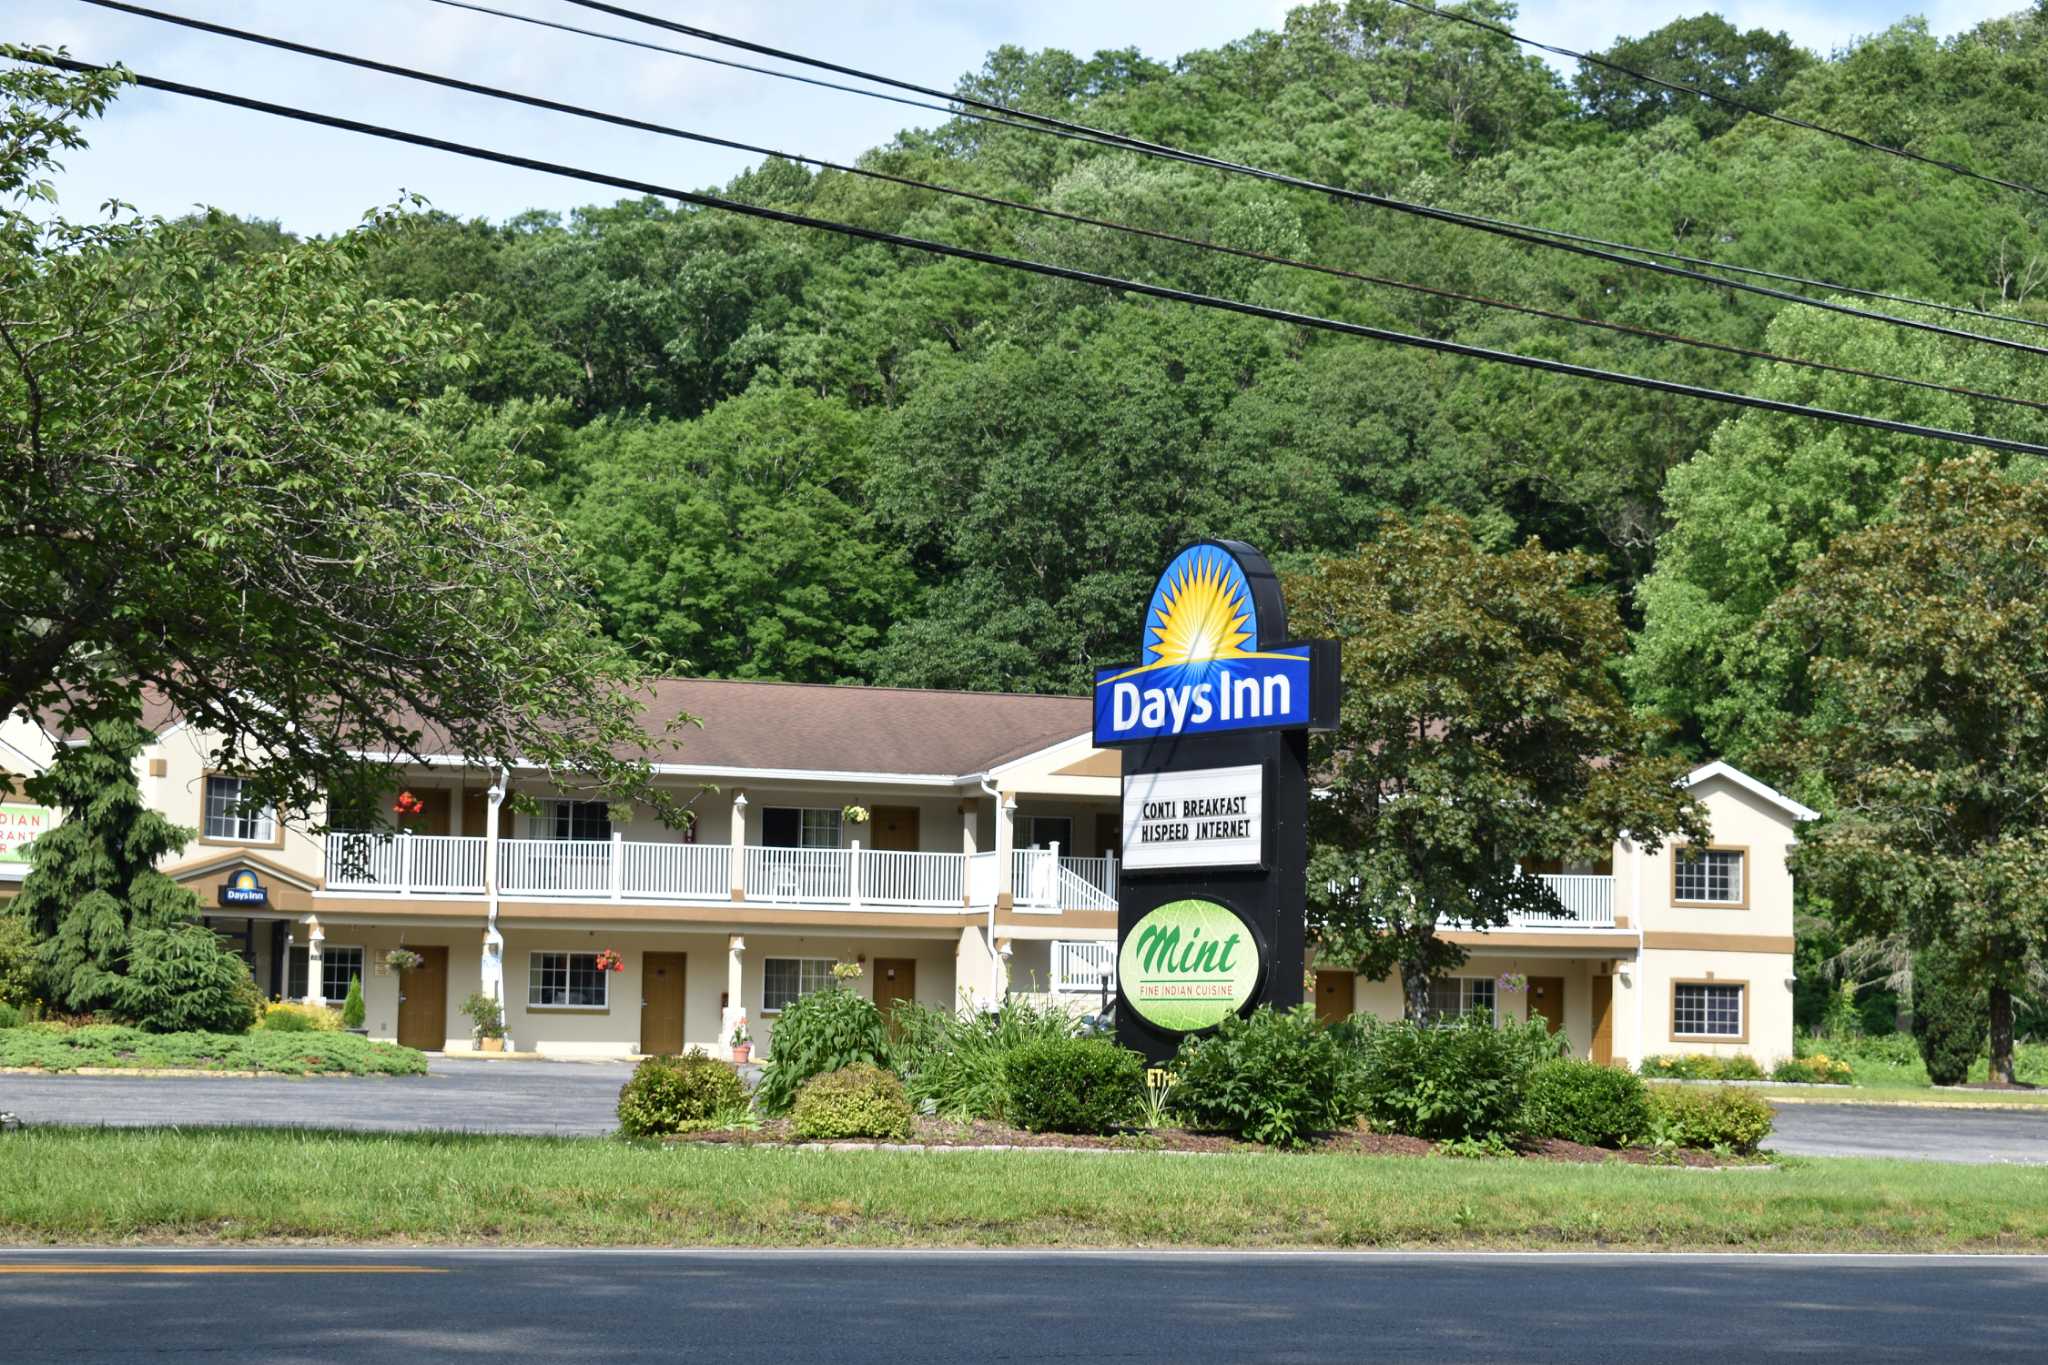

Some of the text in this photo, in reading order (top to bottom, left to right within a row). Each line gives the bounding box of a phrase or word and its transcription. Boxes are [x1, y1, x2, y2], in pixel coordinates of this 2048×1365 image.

[1113, 670, 1291, 734] Days Inn
[1143, 796, 1247, 819] CONTI BREAKFAST
[1141, 819, 1251, 843] HISPEED INTERNET
[227, 890, 264, 900] Days Inn
[1136, 924, 1240, 974] Mint
[1140, 983, 1233, 996] FINE INDIAN CUISINE
